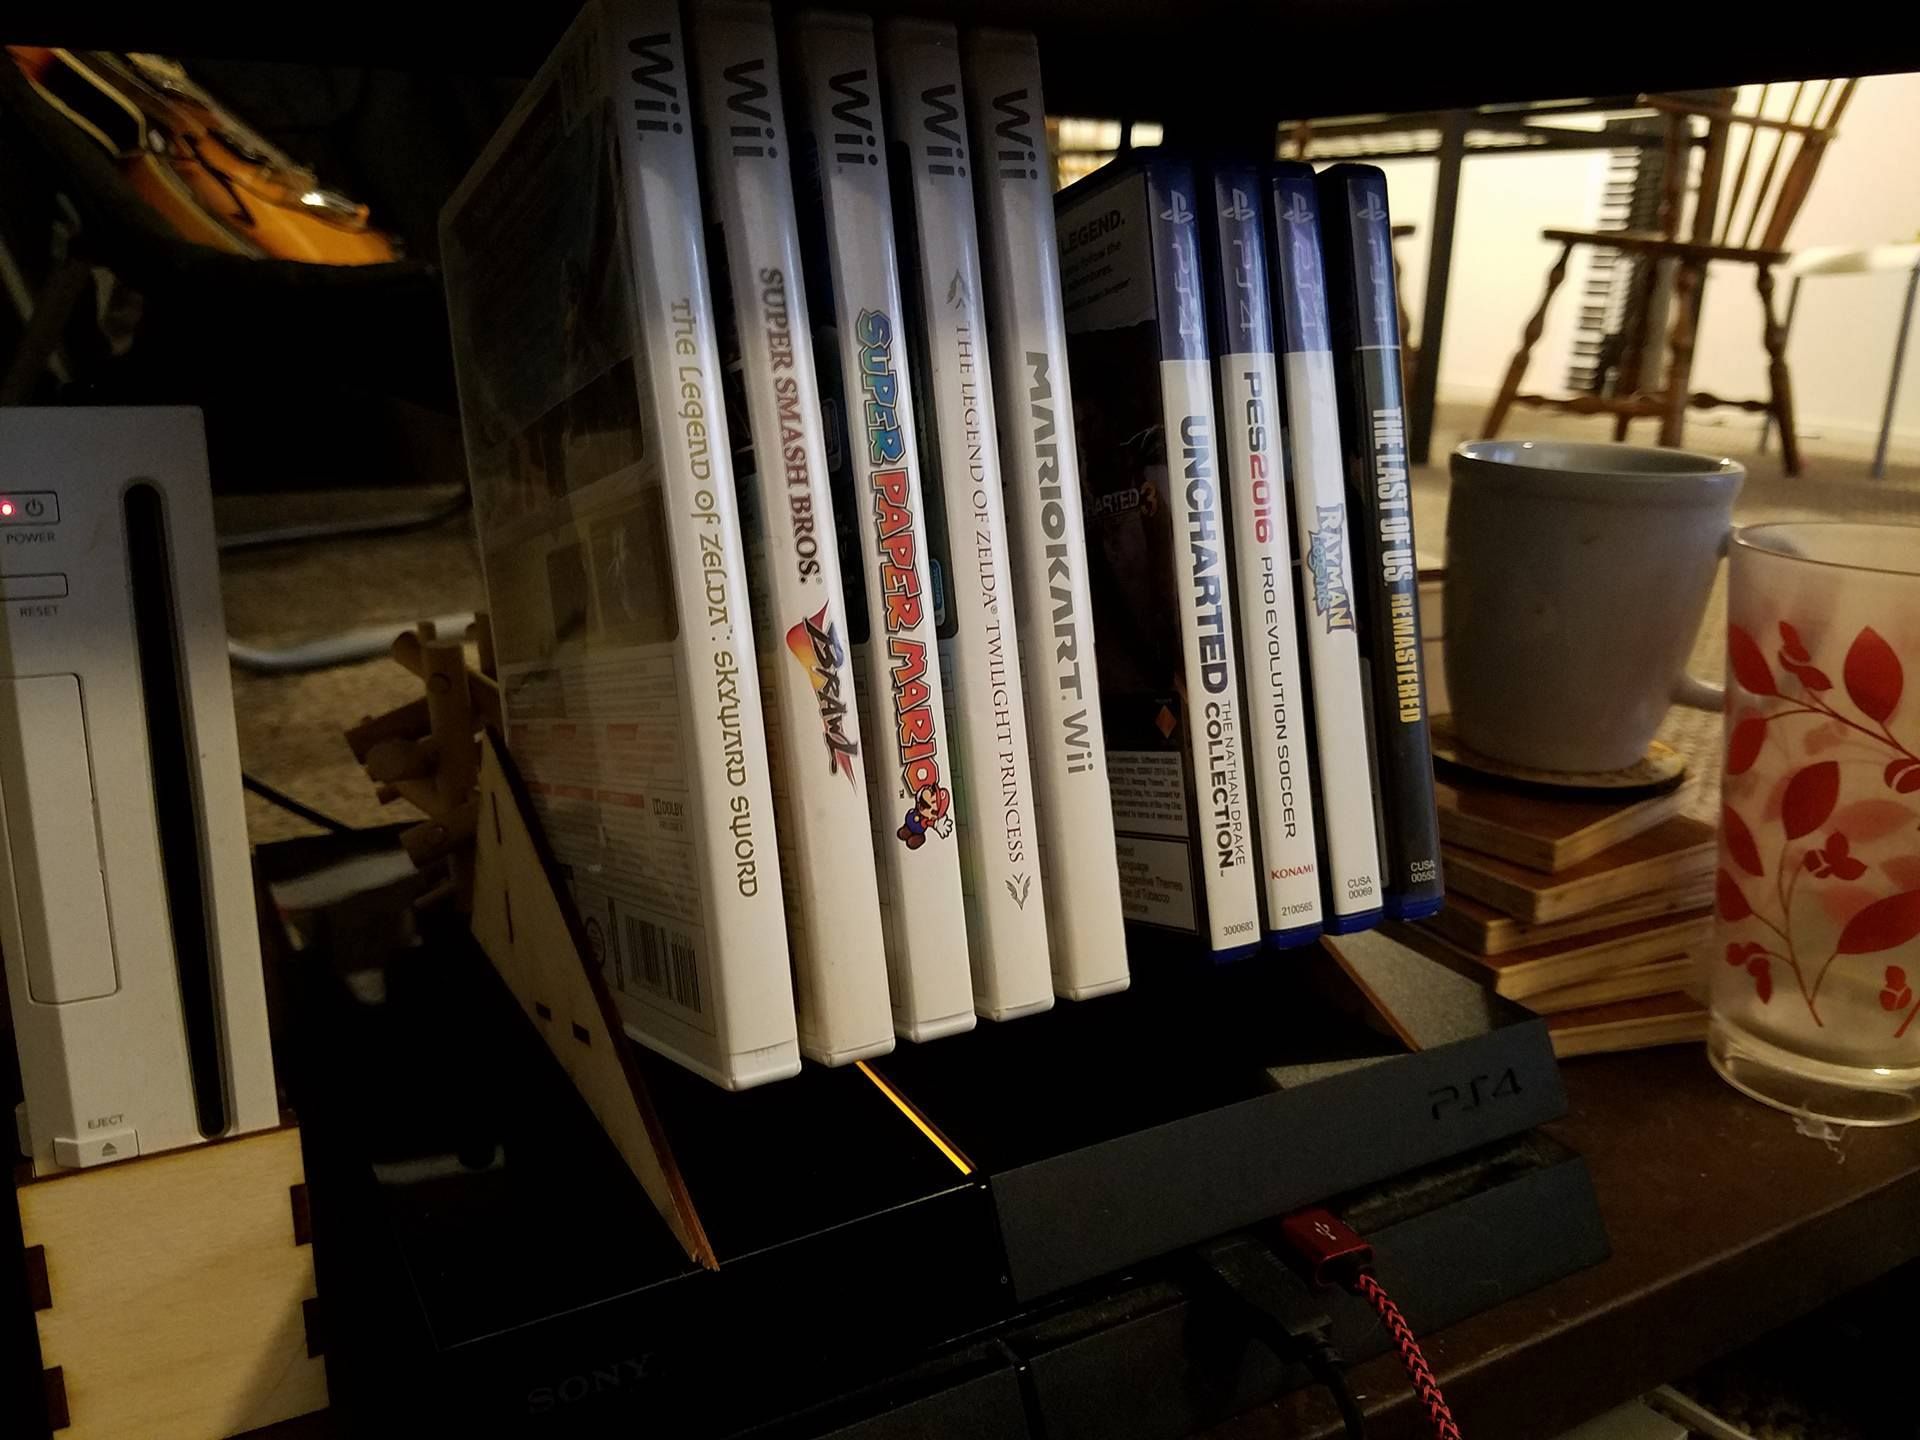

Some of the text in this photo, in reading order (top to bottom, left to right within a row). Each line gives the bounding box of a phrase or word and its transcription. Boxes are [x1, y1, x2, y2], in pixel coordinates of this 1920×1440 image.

[628, 33, 683, 135] Wii
[723, 59, 778, 159] Wii
[829, 69, 878, 166] Wii
[920, 84, 967, 179] Wii
[992, 88, 1038, 180] Wii
[1232, 239, 1258, 333] PS4
[955, 325, 972, 373] THE
[760, 267, 819, 584] SUPER SMASH BROS.
[960, 382, 987, 482] LEGEND
[1372, 406, 1404, 450] THE
[971, 490, 991, 523] OF
[1375, 453, 1409, 512] LAST
[5, 531, 56, 545] POWER
[855, 308, 941, 799] SUPER PAPER MARIO
[1179, 415, 1229, 695] UNCHARTED
[1316, 503, 1357, 635] RAYMAN
[1380, 515, 1411, 545] OF
[19, 604, 60, 618] RESET
[1260, 556, 1276, 605] PRO
[984, 619, 1013, 746] TWILIGHT
[1265, 610, 1289, 741] EVOLUTION
[1390, 592, 1422, 725] REMASTERED
[1062, 708, 1095, 776] Wii
[1204, 702, 1234, 869] COLLECTION
[1220, 700, 1246, 866] THE NATHAN DRAKE
[998, 750, 1026, 864] PRINCESS
[1276, 744, 1297, 839] SOCCER
[1271, 864, 1314, 880] KONAMI
[1347, 876, 1372, 889] CUSA
[1410, 860, 1436, 872] CUSA
[87, 1113, 124, 1130] EJECT
[1427, 1067, 1523, 1120] PS4
[527, 1351, 656, 1416] SONY
